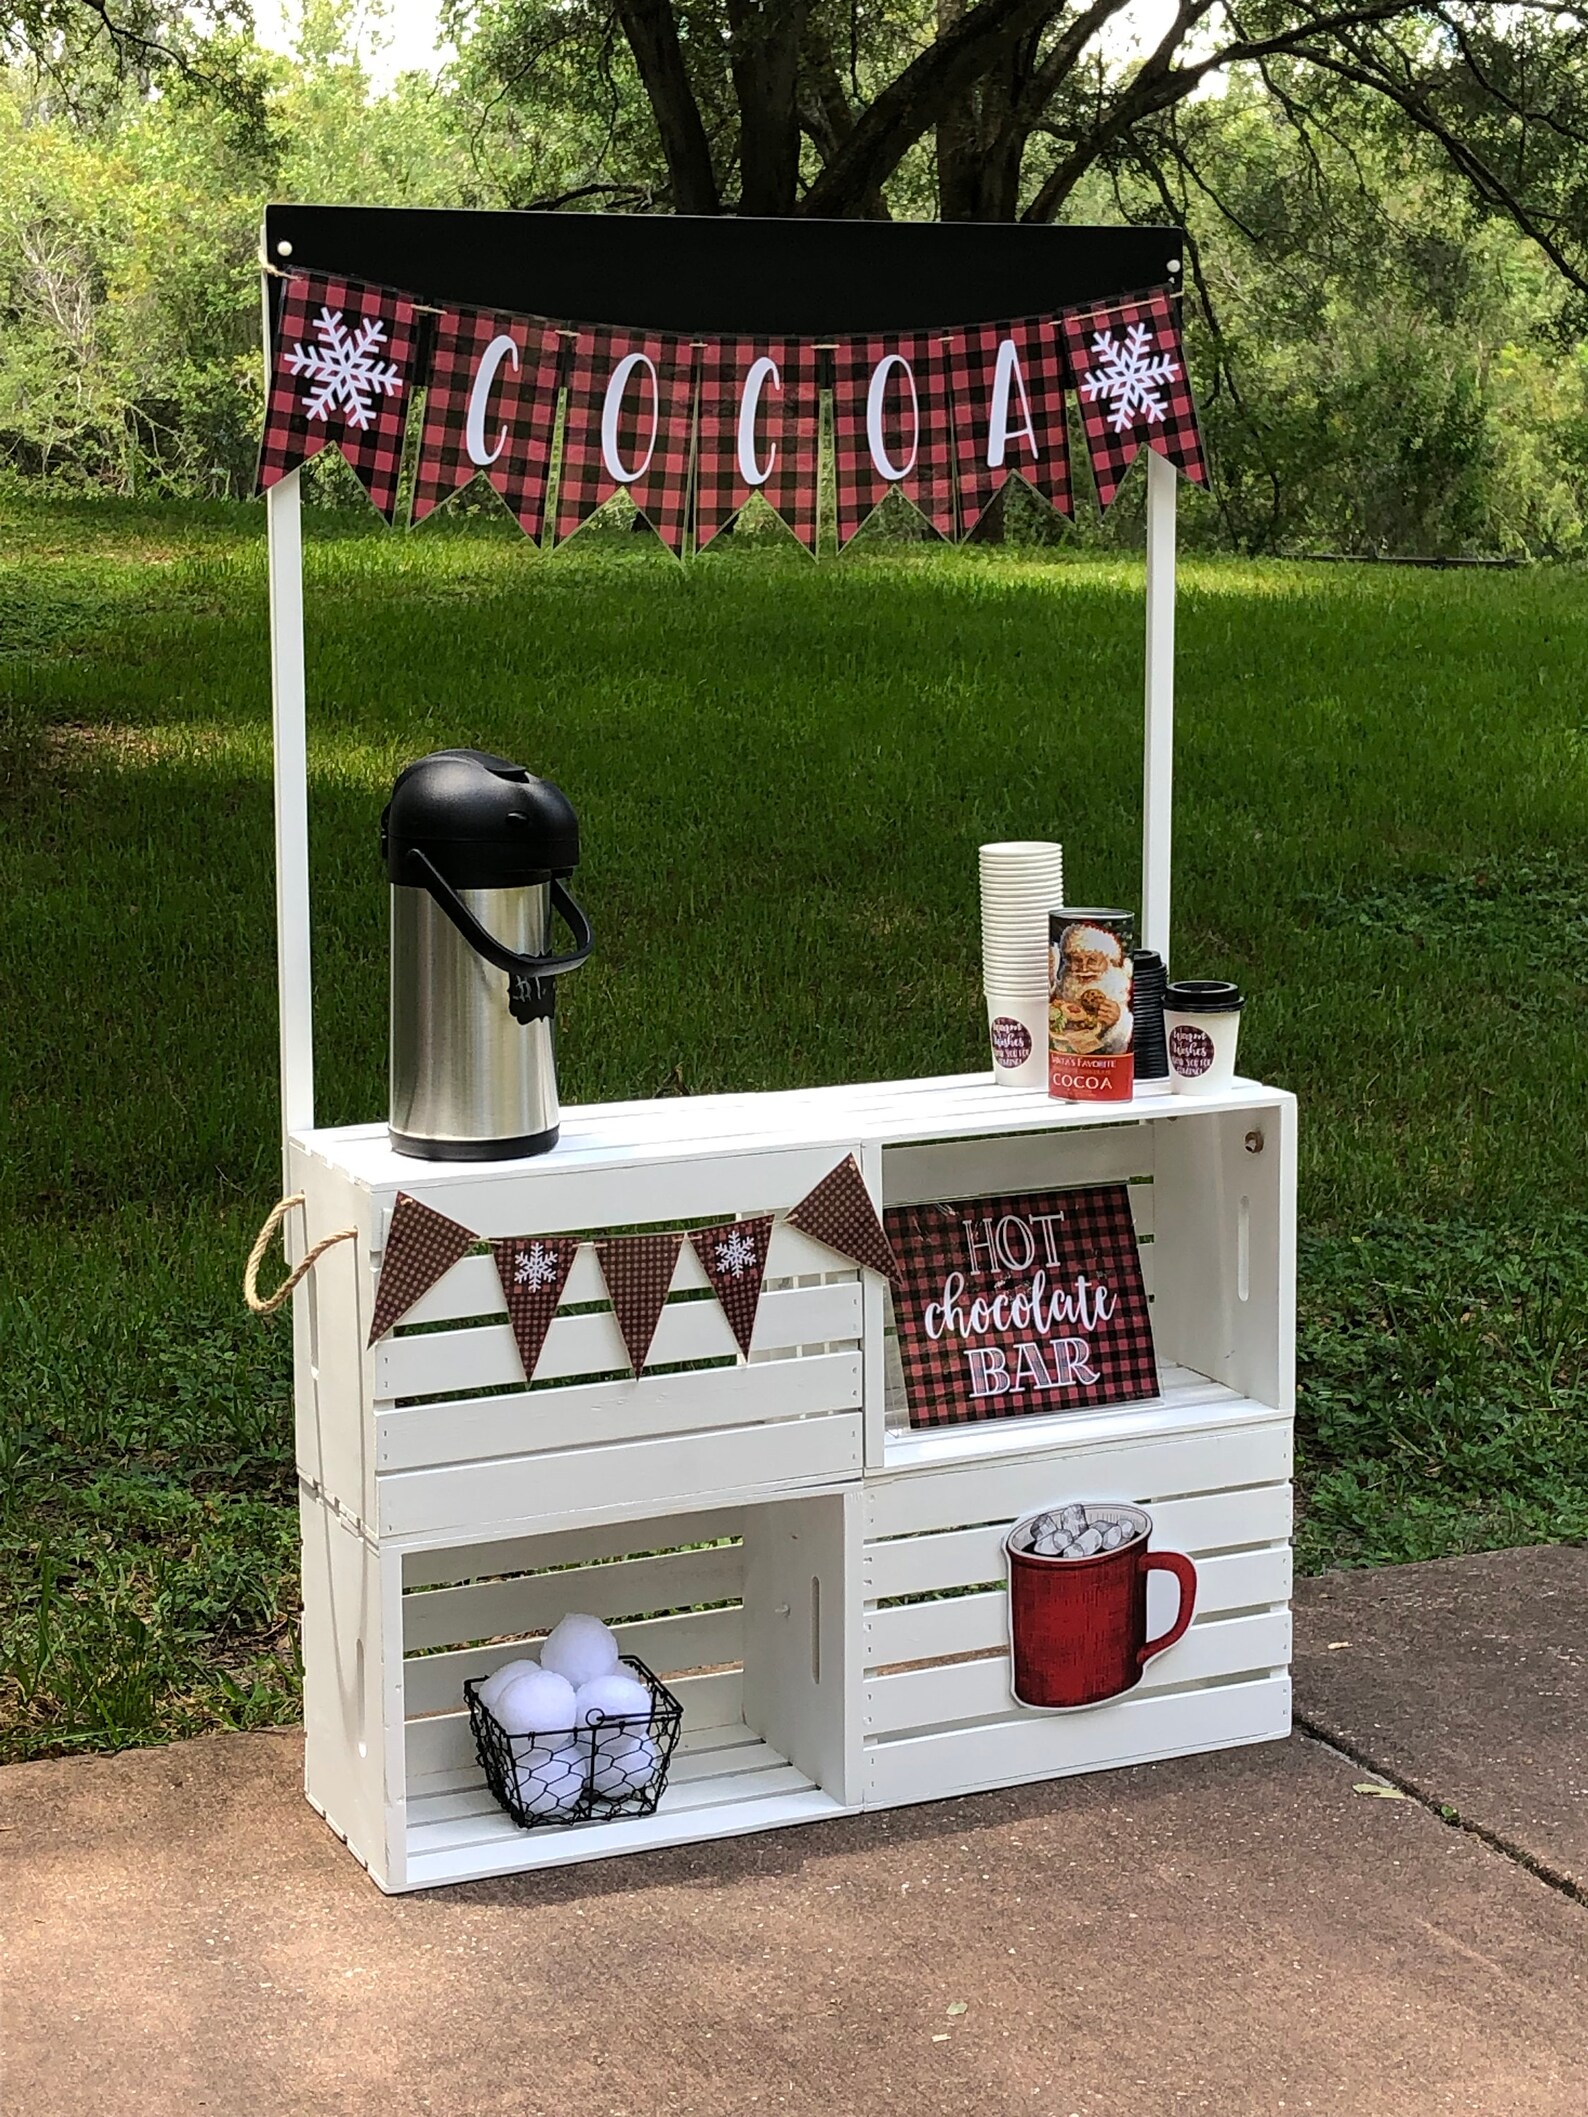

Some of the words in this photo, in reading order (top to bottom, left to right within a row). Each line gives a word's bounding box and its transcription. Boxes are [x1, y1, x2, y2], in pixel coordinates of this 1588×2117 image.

[466, 334, 1039, 486] COCOA
[1053, 1072, 1113, 1090] COCOA
[1077, 1057, 1116, 1068] FAVORITE
[962, 1211, 1065, 1275] HOT
[924, 1269, 1117, 1339] chocolate
[963, 1337, 1101, 1398] BAR
